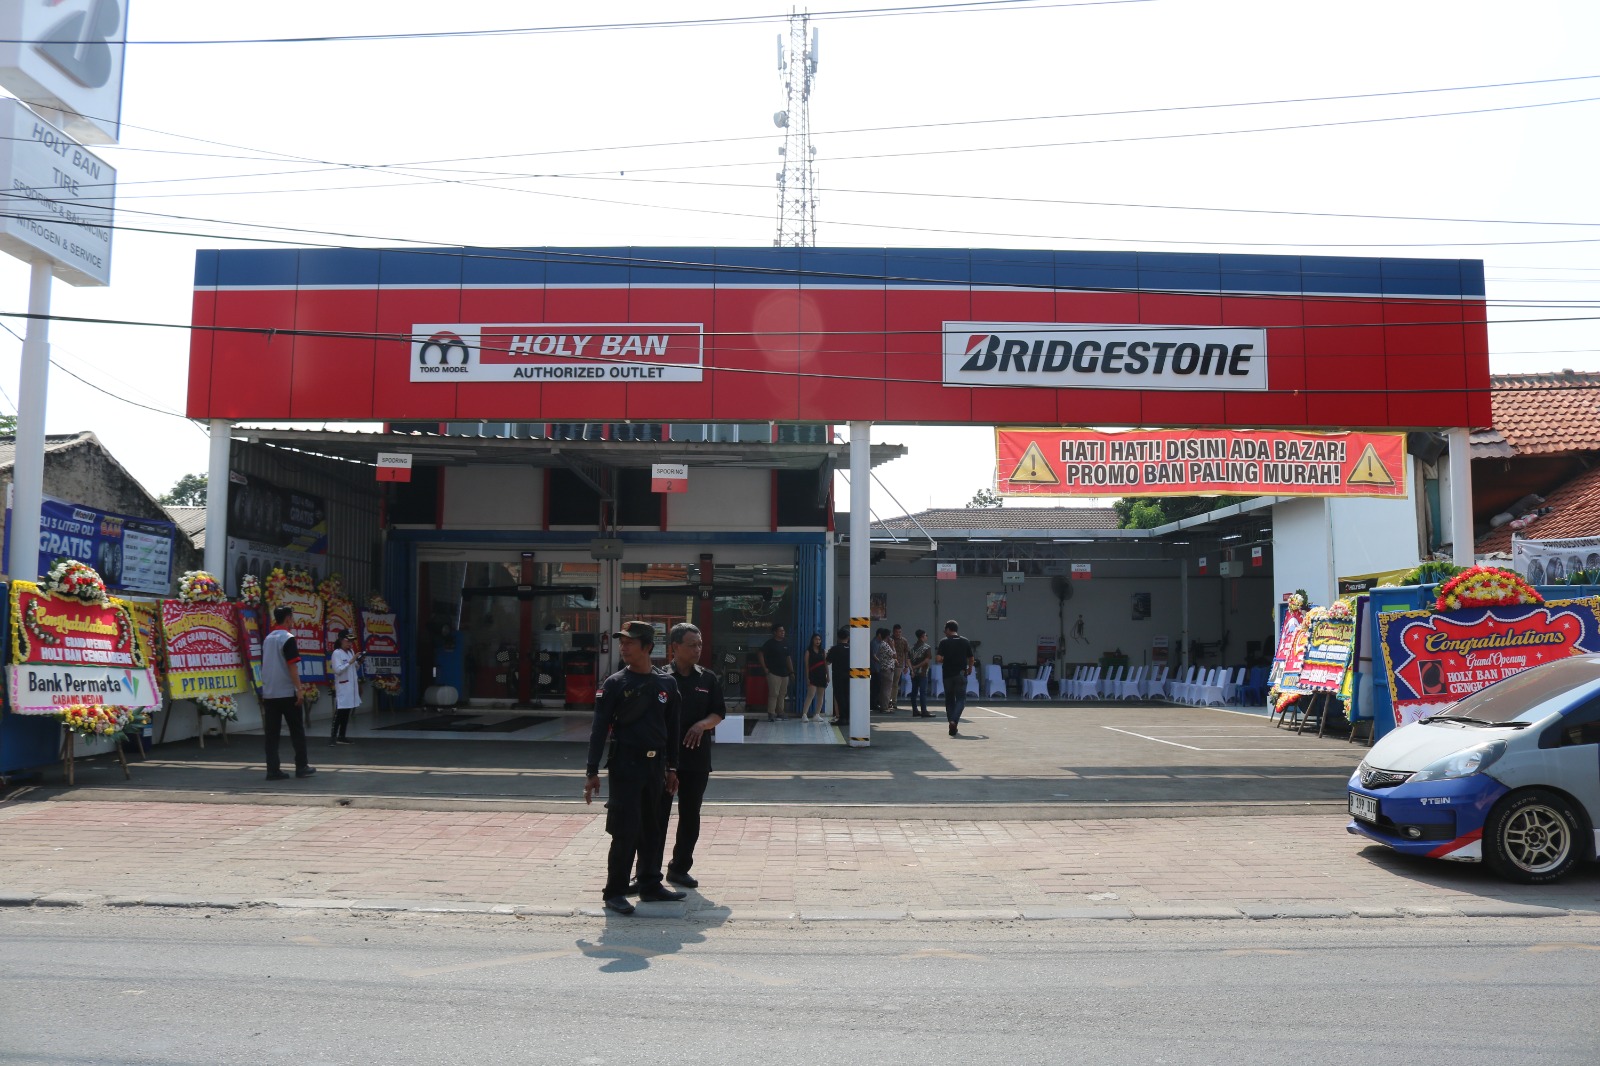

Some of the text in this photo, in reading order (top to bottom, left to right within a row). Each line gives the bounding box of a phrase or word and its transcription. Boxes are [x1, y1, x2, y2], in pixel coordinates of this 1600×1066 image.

[32, 122, 101, 181] HOLY BAN
[52, 166, 80, 198] TIRE
[13, 177, 109, 244] SPOORING & BALANCING
[16, 213, 102, 270] NITROGEN & SERVICE
[508, 335, 669, 356] HOLY BAN
[959, 332, 1254, 376] BRIDGESTONE
[513, 366, 665, 378] AUTHORIZED OUTLET
[1060, 439, 1346, 462] HATI HATI! DISINI ADA BAZAR!
[1066, 462, 1341, 485] PROMO BAN PALING MURAH!
[666, 480, 672, 491] 2
[40, 516, 95, 536] ELI 3 LITER OLI
[39, 531, 93, 559] GRATIS
[65, 636, 112, 650] GRAND OPENING
[174, 638, 187, 652] FOR
[187, 631, 207, 644] GRAND
[1425, 628, 1566, 656] Congratulations
[41, 647, 63, 660] HOLY
[64, 648, 82, 661] BAN
[169, 654, 186, 668] HOLY
[187, 653, 201, 667] BAN
[1465, 652, 1527, 669] Grand Opening
[29, 671, 121, 693] Bank Permata
[181, 675, 238, 691] PT PIRELLI
[1447, 671, 1473, 683] HOLY
[1476, 669, 1498, 680] BAN
[52, 695, 104, 705] CABANG MEDAN
